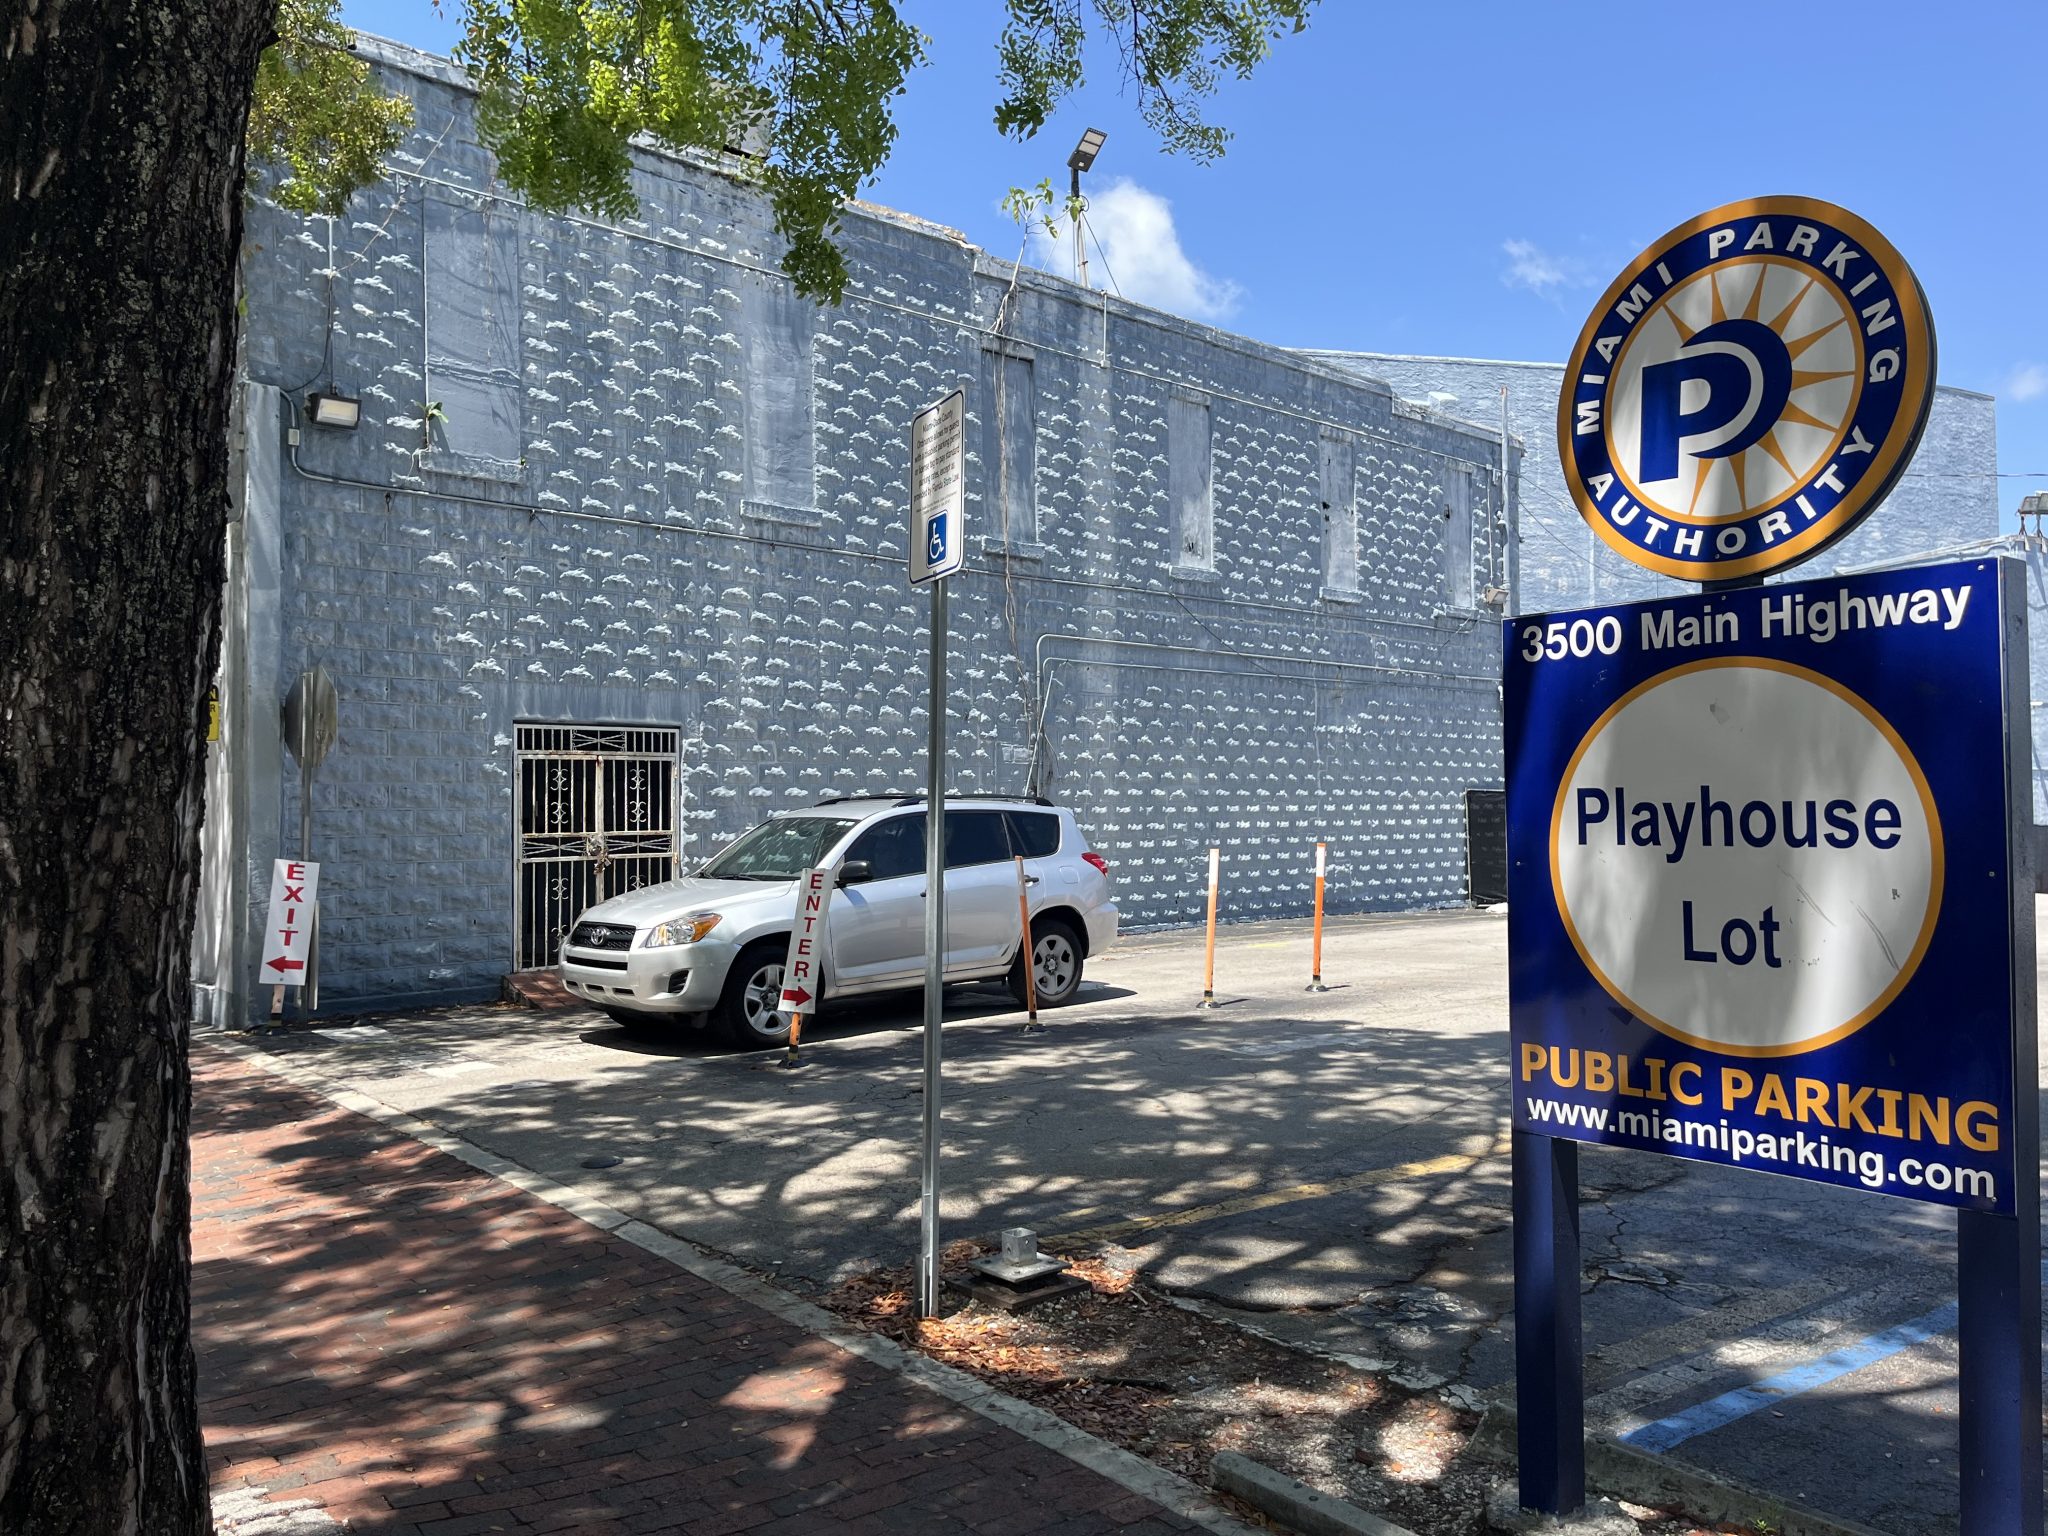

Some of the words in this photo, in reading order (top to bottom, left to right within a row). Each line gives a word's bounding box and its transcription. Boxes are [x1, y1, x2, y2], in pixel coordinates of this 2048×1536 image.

[1577, 262, 1674, 435] MIAMI
[1708, 221, 1900, 385] PARKING
[1588, 424, 1876, 557] AUTHORITY
[1521, 615, 1622, 662] 3500
[1640, 608, 1739, 650] Main
[1761, 585, 1972, 643] Highway
[1577, 785, 1902, 864] Playhouse
[279, 864, 305, 946] EXIT
[793, 873, 824, 978] ENTER
[1682, 901, 1783, 969] Lot
[1520, 1042, 1703, 1107] PUBLIC
[1721, 1067, 1999, 1152] PARKING
[1526, 1096, 1995, 1198] www.miamiparking.com
